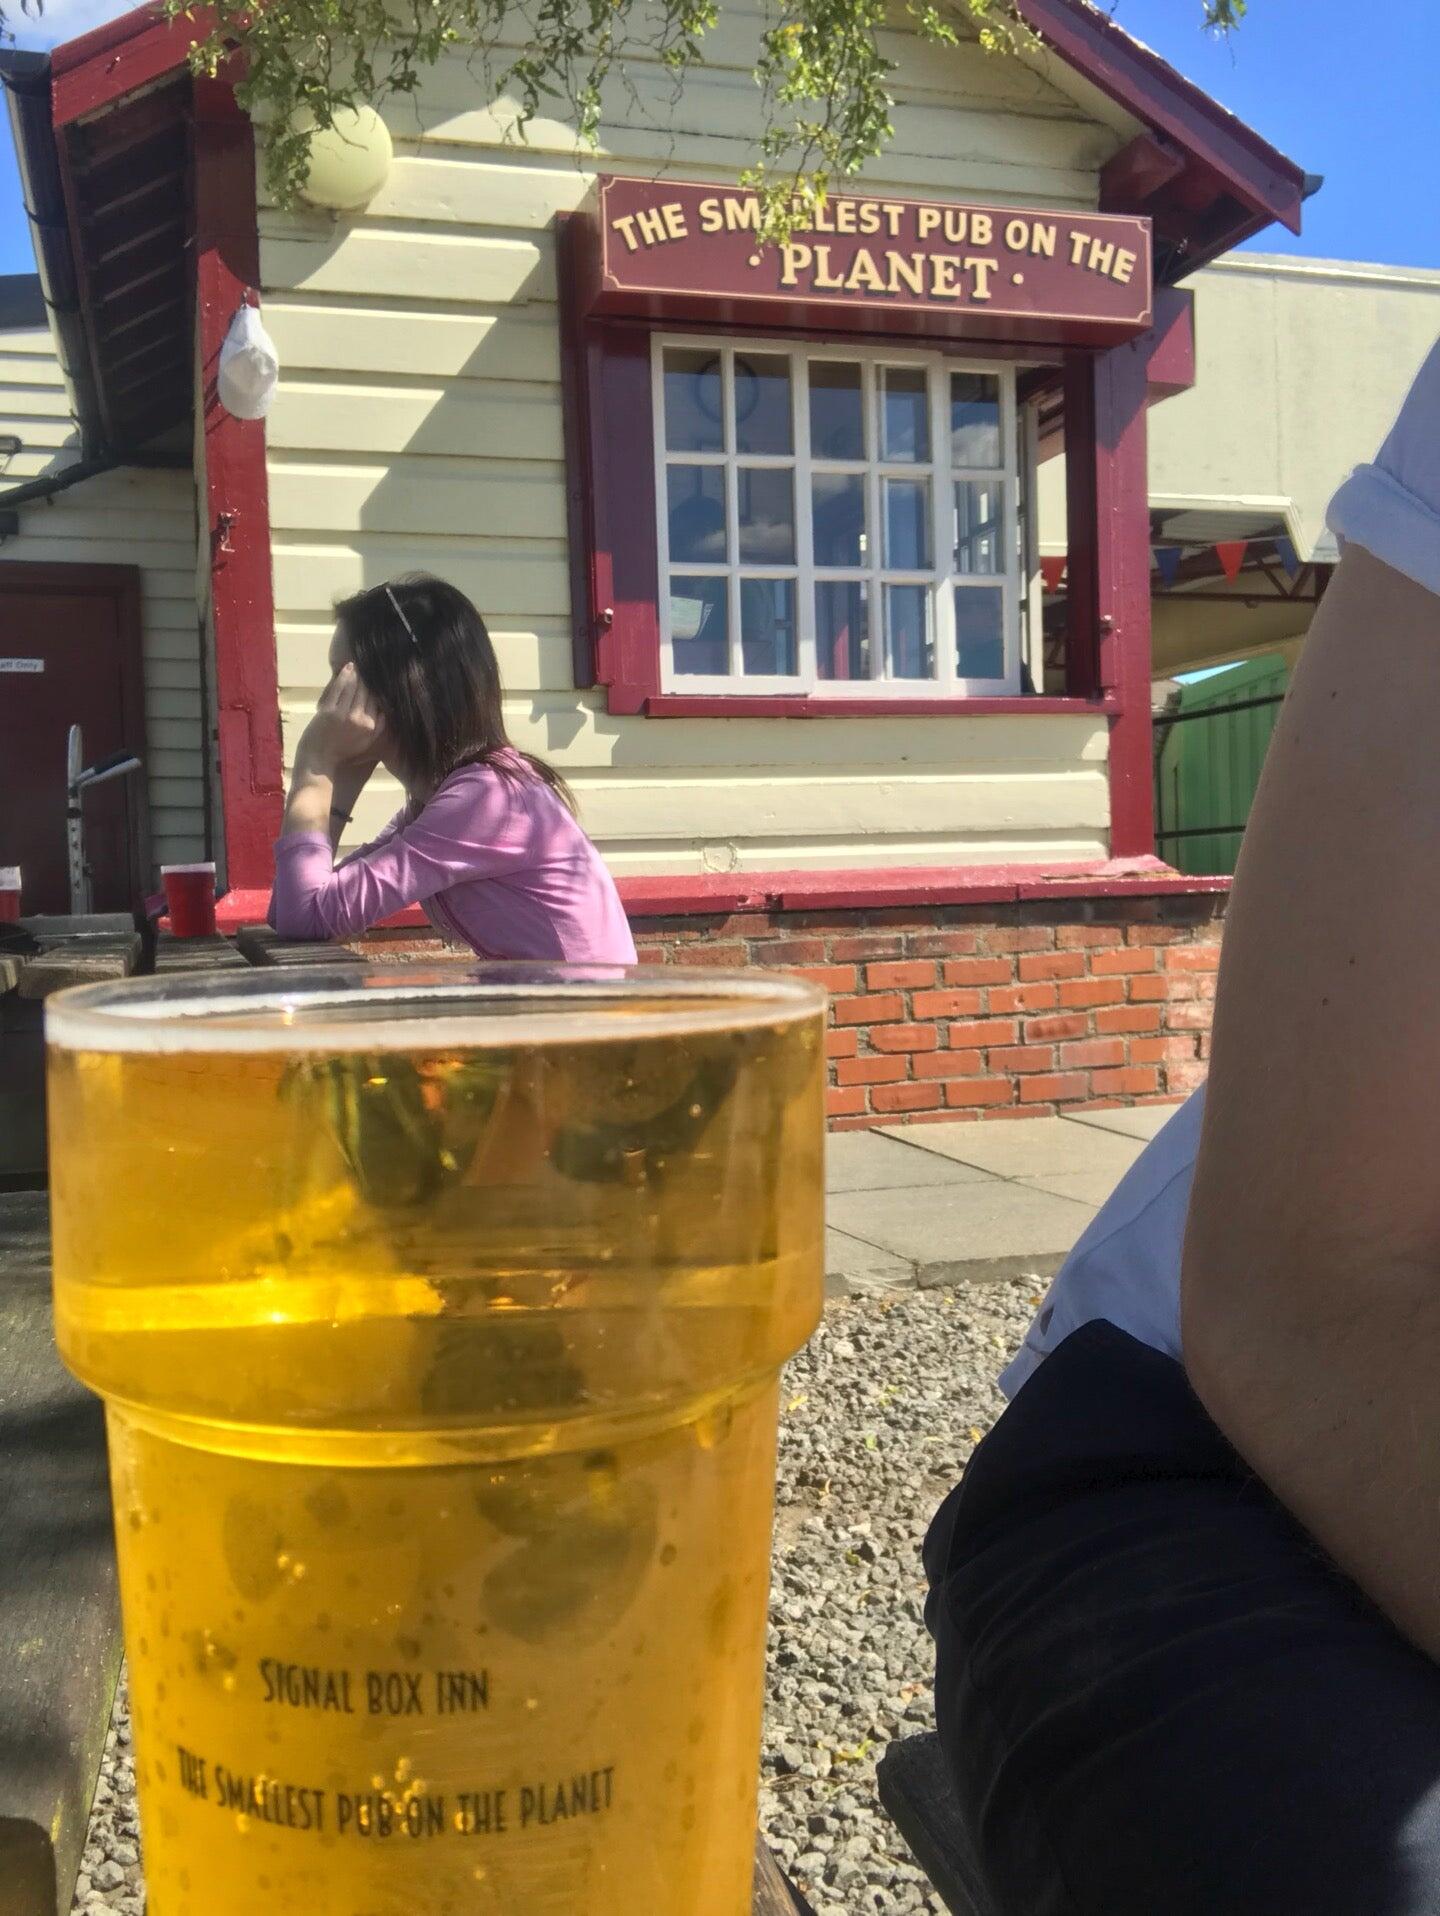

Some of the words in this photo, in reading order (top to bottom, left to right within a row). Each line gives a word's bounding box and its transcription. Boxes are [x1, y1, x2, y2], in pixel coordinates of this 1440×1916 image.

[612, 203, 688, 251] THE
[699, 197, 904, 237] SMLLEST
[918, 208, 993, 245] PUB
[1004, 219, 1056, 257] ON
[1068, 231, 1137, 284] THE
[779, 242, 998, 300] PLANET
[260, 1658, 354, 1713] SIGNAL
[366, 1672, 423, 1715] BOX
[436, 1668, 489, 1715] INN
[178, 1747, 207, 1799] THE
[214, 1764, 325, 1832] SMALLEST
[337, 1793, 393, 1837] PUB
[407, 1797, 445, 1838] ON
[457, 1791, 507, 1835] THE
[520, 1766, 614, 1828] PLANET
